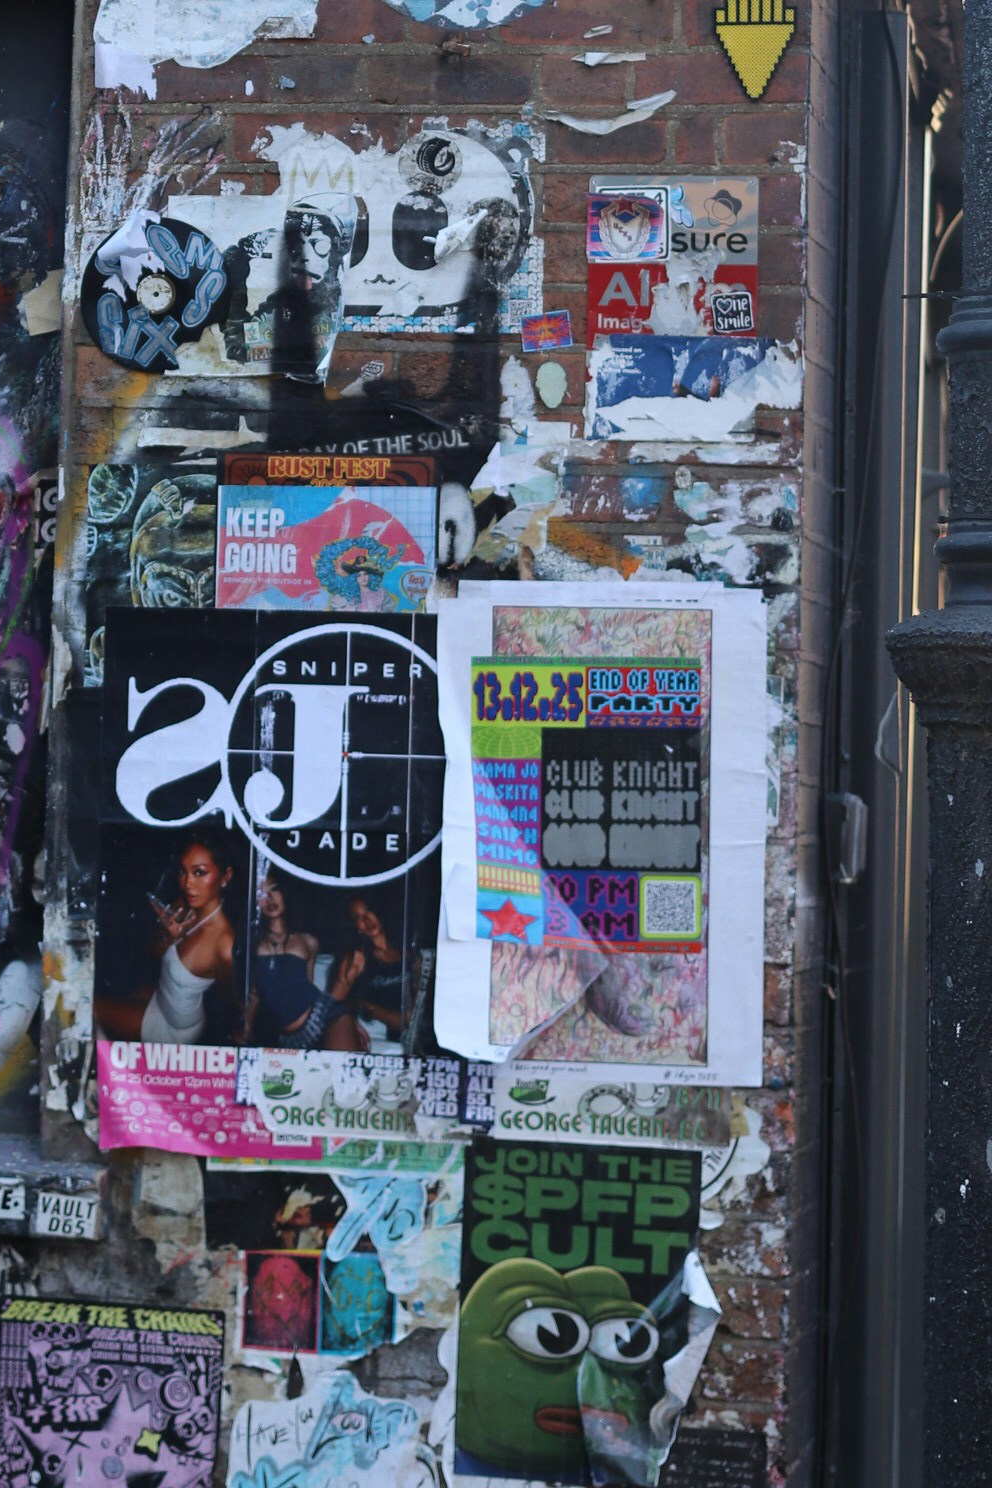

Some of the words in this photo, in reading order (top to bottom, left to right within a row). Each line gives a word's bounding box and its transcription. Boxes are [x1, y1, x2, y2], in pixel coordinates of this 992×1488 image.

[717, 313, 751, 330] smile
[372, 434, 412, 454] THE
[417, 429, 470, 450] SOUL
[268, 456, 331, 478] RUST
[333, 457, 390, 479] FEST
[225, 508, 285, 538] KEEP
[223, 543, 298, 575] GOING
[272, 661, 423, 679] SNIPER
[472, 671, 584, 722] 13.12.25
[588, 669, 623, 692] END
[626, 669, 650, 692] OF
[654, 669, 700, 692] YEAR
[587, 694, 701, 712] PARTY
[472, 762, 516, 779] MAMA
[546, 760, 604, 787] CLUB
[611, 761, 698, 788] KNIGHT
[544, 789, 605, 820] CLUB
[287, 830, 400, 852] JADE
[477, 841, 539, 866] MIMO
[545, 875, 578, 903] 10
[586, 876, 638, 905] PM
[580, 911, 638, 939] AM
[110, 1040, 143, 1070] OF
[110, 1070, 127, 1083] Sat
[128, 1072, 141, 1084] 25
[142, 1073, 182, 1086] October
[500, 1110, 581, 1133] GEORGE
[474, 1148, 583, 1177] JOIN
[598, 1154, 692, 1183] THE
[41, 1195, 96, 1220] VAULT
[470, 1218, 690, 1276] CULT
[0, 1300, 85, 1324] BREAK
[86, 1305, 130, 1328] THE
